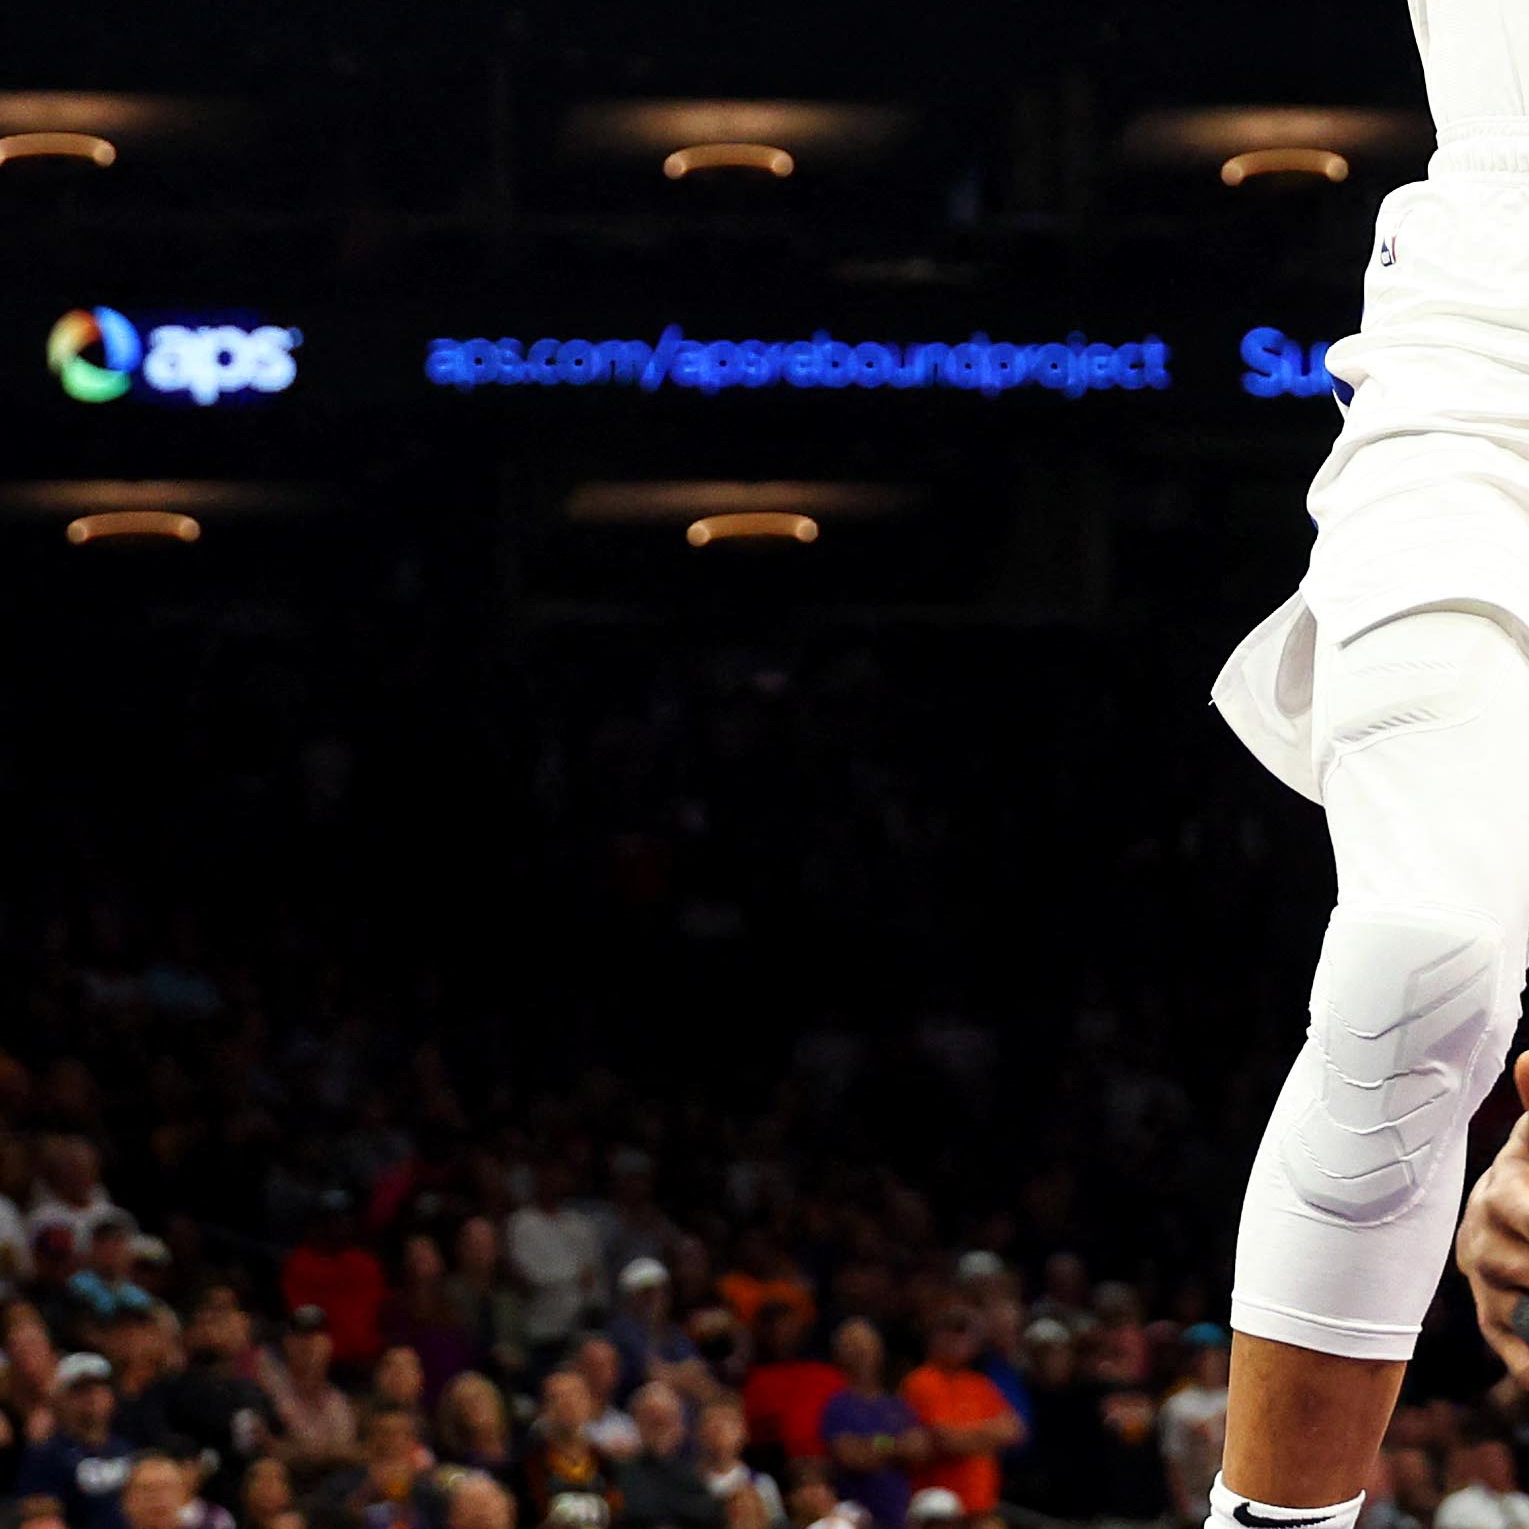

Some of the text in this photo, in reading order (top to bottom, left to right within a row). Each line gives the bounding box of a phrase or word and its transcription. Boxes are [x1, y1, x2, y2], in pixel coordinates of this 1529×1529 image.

[143, 325, 298, 406] aps
[424, 324, 1172, 399] aps.com/apsreboundproject
[1240, 326, 1334, 398] Su
